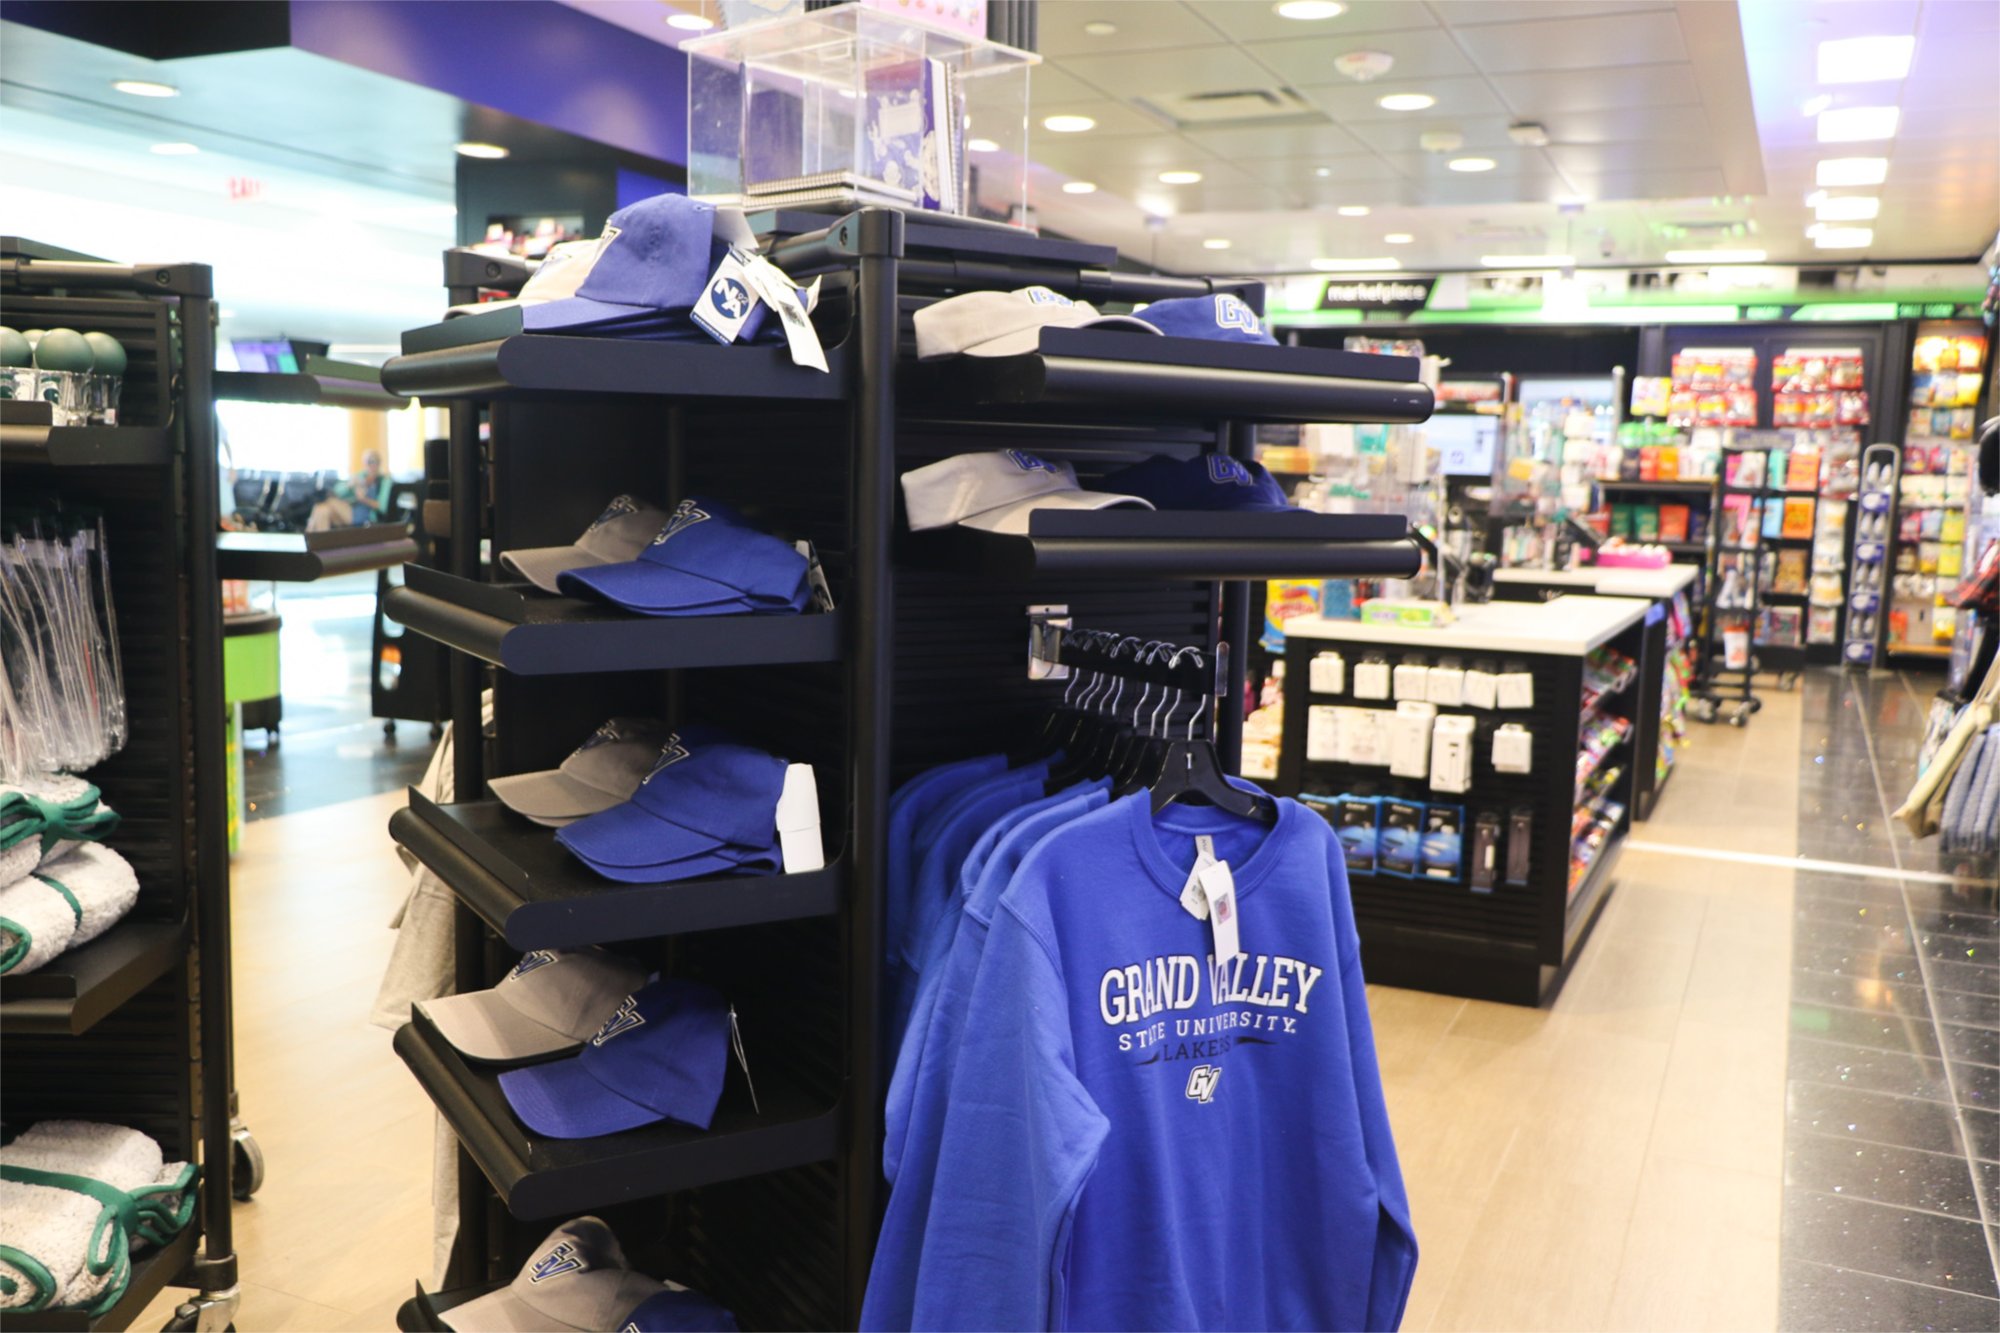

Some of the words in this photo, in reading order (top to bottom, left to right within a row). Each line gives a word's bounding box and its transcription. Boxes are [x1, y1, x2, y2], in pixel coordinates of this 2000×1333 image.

[1328, 283, 1427, 304] marketplace
[1100, 954, 1201, 1026] GRAND
[1206, 951, 1323, 1014] VALLEY
[1118, 1021, 1166, 1051] STATE
[1176, 1011, 1295, 1037] UNIVERSITY
[1162, 1034, 1231, 1062] LAKES
[1185, 1063, 1222, 1105] GV
